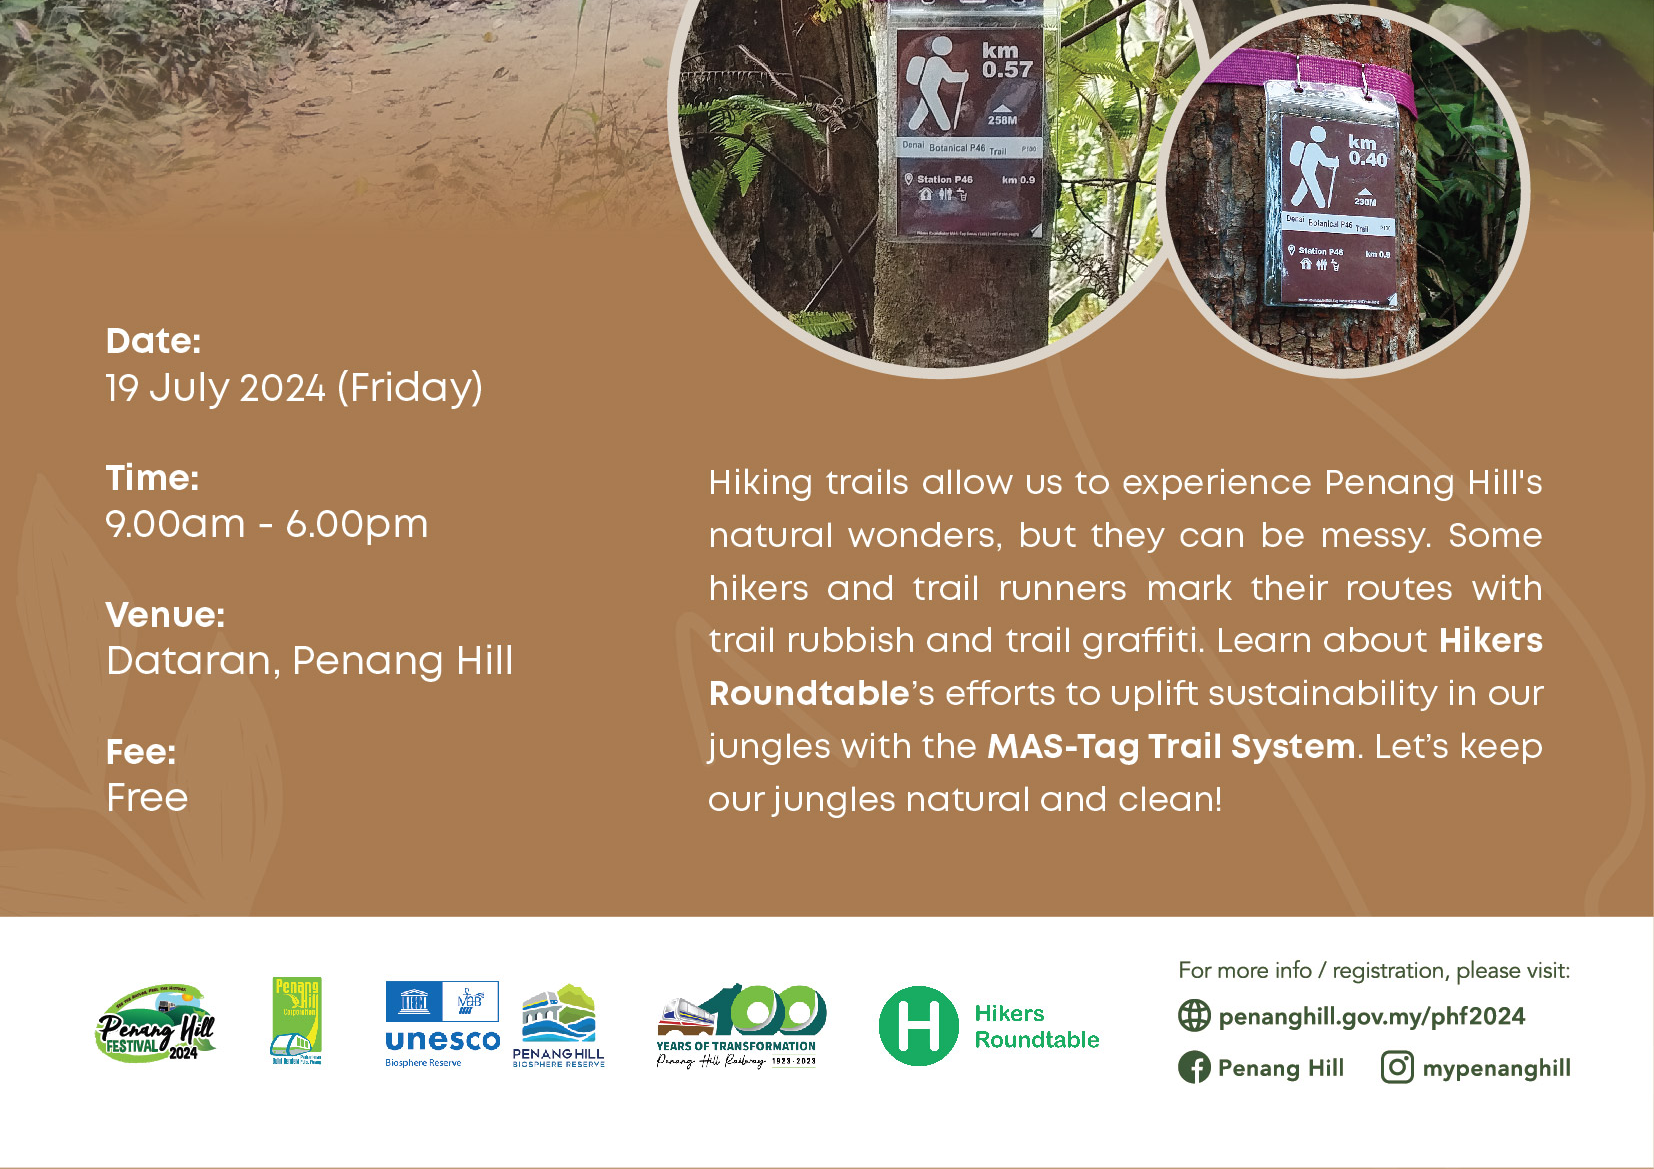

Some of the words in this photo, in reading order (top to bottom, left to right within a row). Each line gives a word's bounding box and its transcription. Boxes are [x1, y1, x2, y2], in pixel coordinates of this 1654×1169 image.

[982, 42, 1018, 58] km
[982, 60, 1033, 78] 0.57
[988, 116, 1018, 125] 258M
[930, 144, 968, 152] Botanical
[970, 144, 986, 152] P46
[1349, 134, 1377, 150] km
[1349, 152, 1388, 168] 0.40
[917, 176, 952, 184] Station
[955, 176, 973, 184] P46
[1002, 176, 1017, 184] km
[1020, 176, 1036, 184] 0.9
[1299, 247, 1326, 255] Station
[108, 328, 199, 353] Date:
[106, 374, 138, 401] 19
[150, 372, 229, 409] July
[241, 374, 325, 401] 2024
[339, 370, 481, 409] (Friday)
[106, 463, 197, 490] Time:
[711, 469, 811, 501] Hiking
[827, 469, 908, 494] trails
[923, 470, 1013, 494] allow
[1027, 475, 1062, 494] us
[1076, 471, 1109, 494] to
[1124, 469, 1311, 500] experience
[1327, 470, 1453, 501] Penang
[1470, 469, 1542, 494] Hill's
[106, 510, 243, 537] 9.00am
[287, 510, 426, 545] 6.00pm
[711, 523, 831, 547] natural
[848, 522, 1001, 551] wonders,
[1021, 522, 1076, 547] but
[1092, 522, 1164, 553] they
[1181, 528, 1243, 547] can
[1263, 522, 1304, 547] be
[1323, 528, 1430, 553] messy.
[1450, 523, 1542, 547] Some
[711, 575, 808, 600] hikers
[828, 575, 892, 600] and
[913, 575, 977, 600] trail
[1001, 581, 1126, 600] runners
[1149, 575, 1232, 600] mark
[1251, 575, 1328, 600] their
[1348, 578, 1452, 600] routes
[1472, 575, 1541, 600] with
[105, 602, 223, 627] Venue:
[710, 627, 773, 652] trail
[789, 627, 913, 652] rubbish
[927, 627, 991, 652] and
[1007, 627, 1069, 652] trail
[1083, 627, 1203, 659] graffiti.
[1219, 628, 1310, 652] Learn
[1324, 627, 1427, 652] about
[1441, 626, 1542, 652] Hikers
[109, 646, 279, 678] Dataran,
[295, 646, 441, 682] Penang
[459, 645, 511, 674] Hill
[711, 680, 934, 705] Roundtable’s
[947, 680, 1055, 705] efforts
[1067, 683, 1100, 705] to
[1112, 680, 1198, 711] uplift
[1210, 680, 1438, 711] sustainability
[1450, 680, 1475, 705] in
[1489, 686, 1544, 705] our
[108, 739, 174, 764] Fee:
[707, 733, 830, 765] jungles
[841, 733, 910, 758] with
[923, 733, 976, 758] the
[988, 734, 1138, 765] MAS-Tag
[1149, 732, 1220, 758] Trail
[1232, 734, 1362, 764] System.
[1377, 734, 1448, 758] Let’s
[1462, 733, 1542, 764] keep
[109, 783, 187, 811] Free
[709, 792, 765, 811] our
[772, 786, 895, 818] jungles
[908, 787, 1028, 811] natural
[1041, 786, 1105, 811] and
[1120, 787, 1220, 811] clean!
[1180, 961, 1212, 978] For
[1218, 966, 1268, 978] more
[1276, 960, 1312, 978] info
[1318, 961, 1327, 978] /
[1334, 962, 1449, 984] registration,
[1457, 960, 1520, 985] please
[1527, 962, 1569, 978] visit:
[276, 979, 318, 993] Penang
[699, 983, 827, 1036] 100
[976, 1005, 1044, 1021] Hikers
[1220, 1006, 1526, 1030] penanghill.gov.my/phf2024
[99, 1015, 175, 1051] Penang
[181, 1015, 215, 1045] Hill
[898, 1000, 940, 1052] H
[107, 1039, 158, 1052] FESTIVAL
[386, 1031, 500, 1050] unesco
[657, 1041, 692, 1050] YEARS
[695, 1041, 709, 1050] OF
[712, 1041, 815, 1050] TRANSFORMATION
[976, 1031, 1099, 1048] Roundtable
[170, 1047, 197, 1059] 2024
[386, 1058, 427, 1068] Biosphere
[430, 1058, 462, 1067] Reserve
[512, 1048, 573, 1059] PENANG
[574, 1048, 604, 1059] HILL
[657, 1054, 695, 1069] Penang
[699, 1054, 720, 1066] Hill
[725, 1054, 766, 1070] Railway
[1219, 1059, 1299, 1082] Penang
[1309, 1058, 1343, 1076] Hill
[1424, 1058, 1570, 1082] mypenanghill
